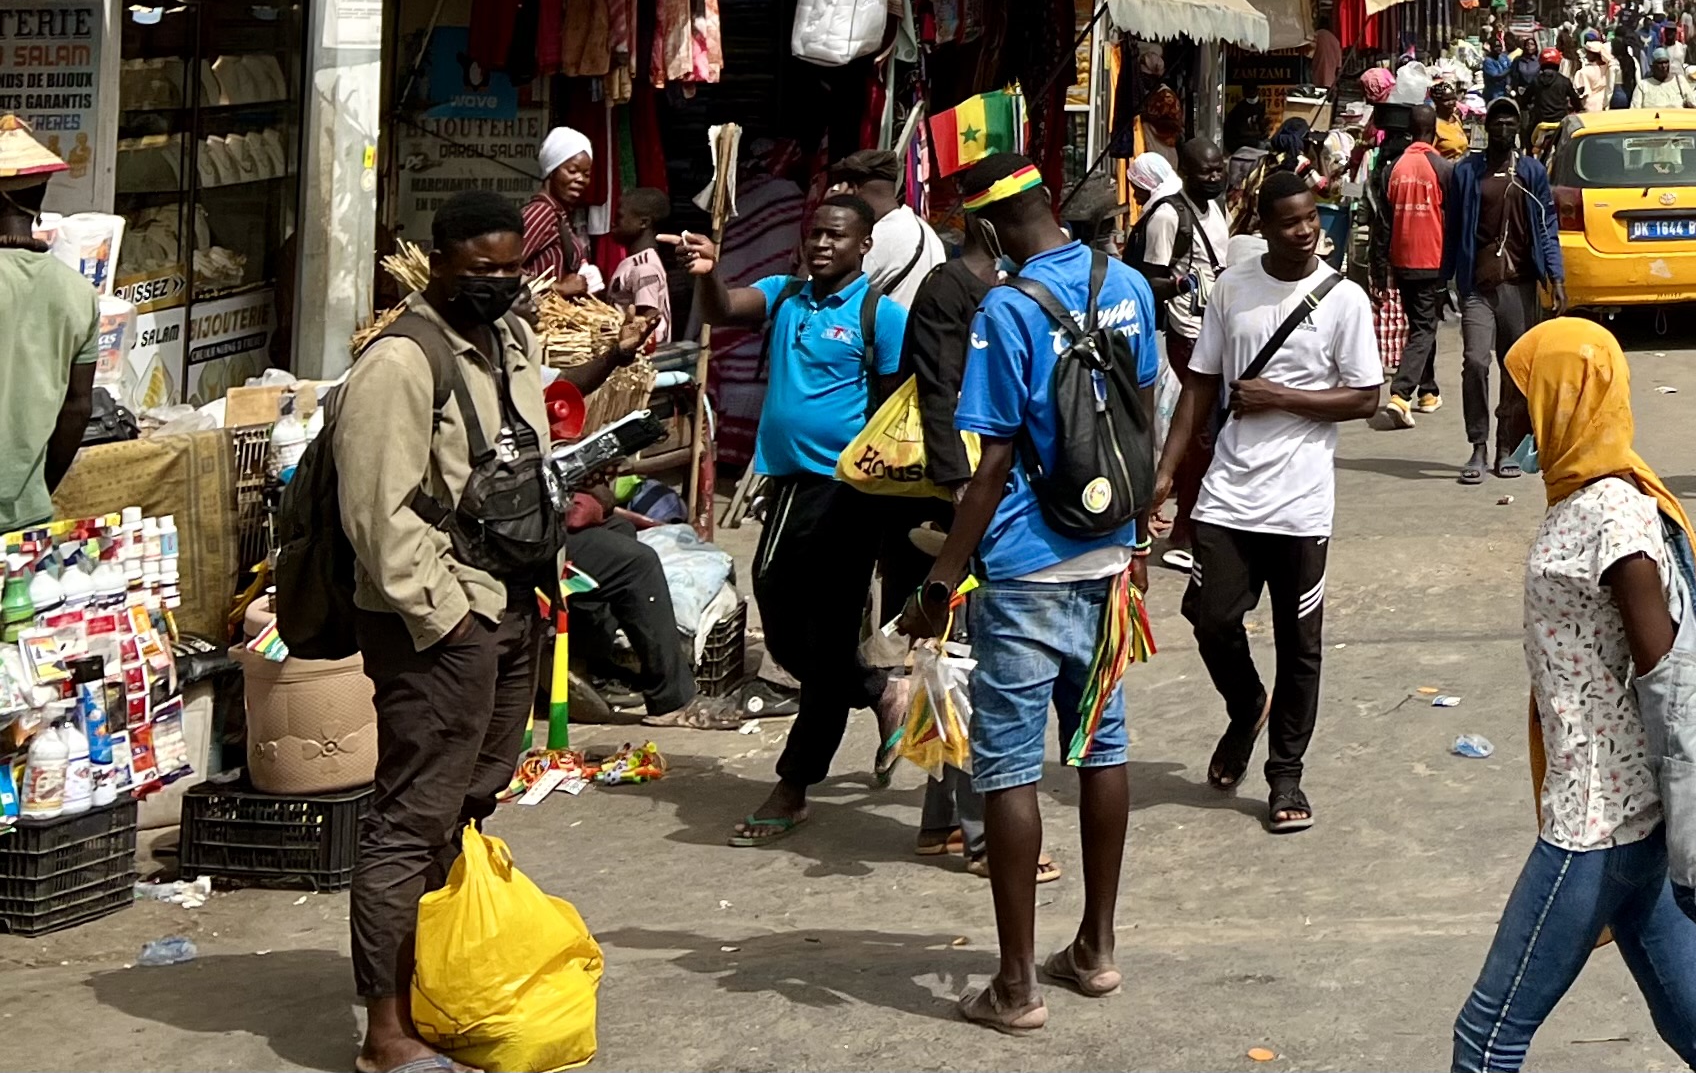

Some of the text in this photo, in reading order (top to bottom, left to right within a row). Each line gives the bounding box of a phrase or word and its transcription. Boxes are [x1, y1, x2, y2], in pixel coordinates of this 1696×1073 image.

[14, 45, 91, 66] SALAM
[27, 73, 43, 88] DE
[46, 72, 93, 87] BIJOUX
[26, 94, 92, 109] GARANTIS
[451, 94, 498, 109] wave
[405, 117, 539, 137] BIJOUTERIE
[490, 143, 536, 159] SALAM
[1634, 222, 1649, 236] DK
[1656, 221, 1684, 235] 1644
[190, 304, 271, 341] BIJOUTERIE
[141, 324, 180, 348] SALAM
[855, 444, 936, 484] Hous
